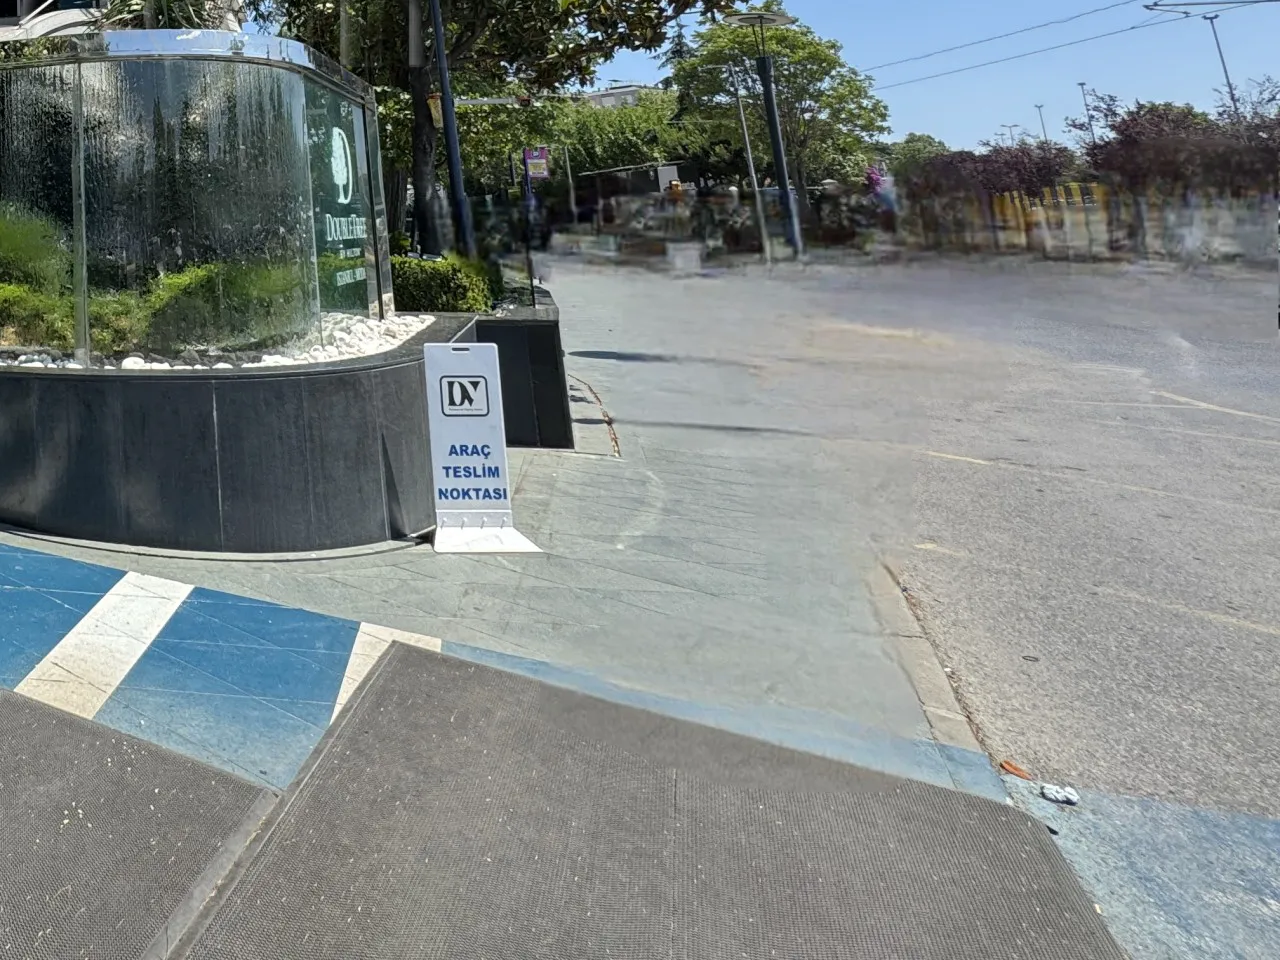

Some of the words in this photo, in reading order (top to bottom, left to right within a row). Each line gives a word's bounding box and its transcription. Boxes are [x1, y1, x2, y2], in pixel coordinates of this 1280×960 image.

[448, 444, 491, 460] ARAÇ
[442, 463, 500, 479] TESLİM
[438, 487, 508, 501] NOKTASI
